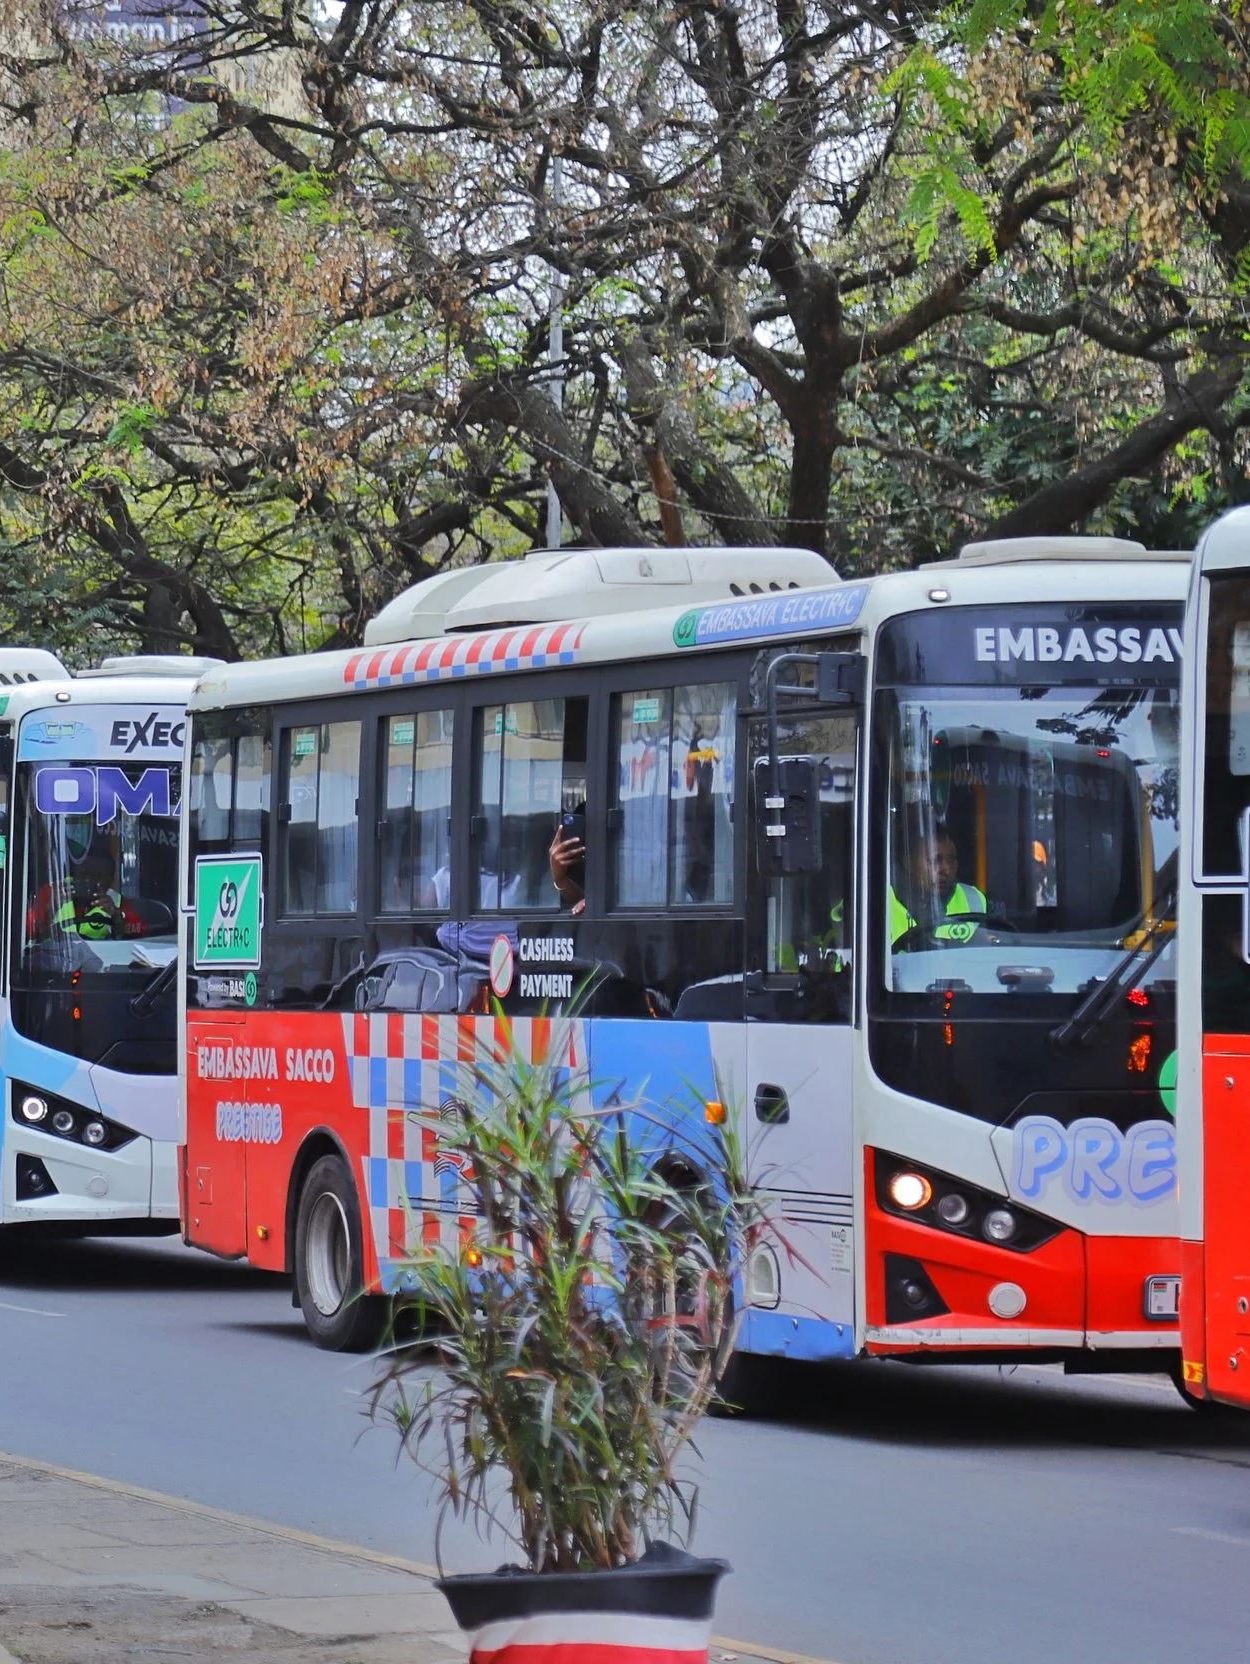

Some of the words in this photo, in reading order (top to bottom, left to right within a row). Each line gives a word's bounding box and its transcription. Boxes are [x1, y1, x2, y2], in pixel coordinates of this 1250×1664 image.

[697, 602, 779, 636] EMBASSAVA
[35, 767, 182, 826] OM
[519, 937, 574, 962] CASHLESS
[520, 974, 573, 998] PAYMENT
[198, 1046, 279, 1080] EMBASSAVA
[286, 1047, 335, 1083] SACCO
